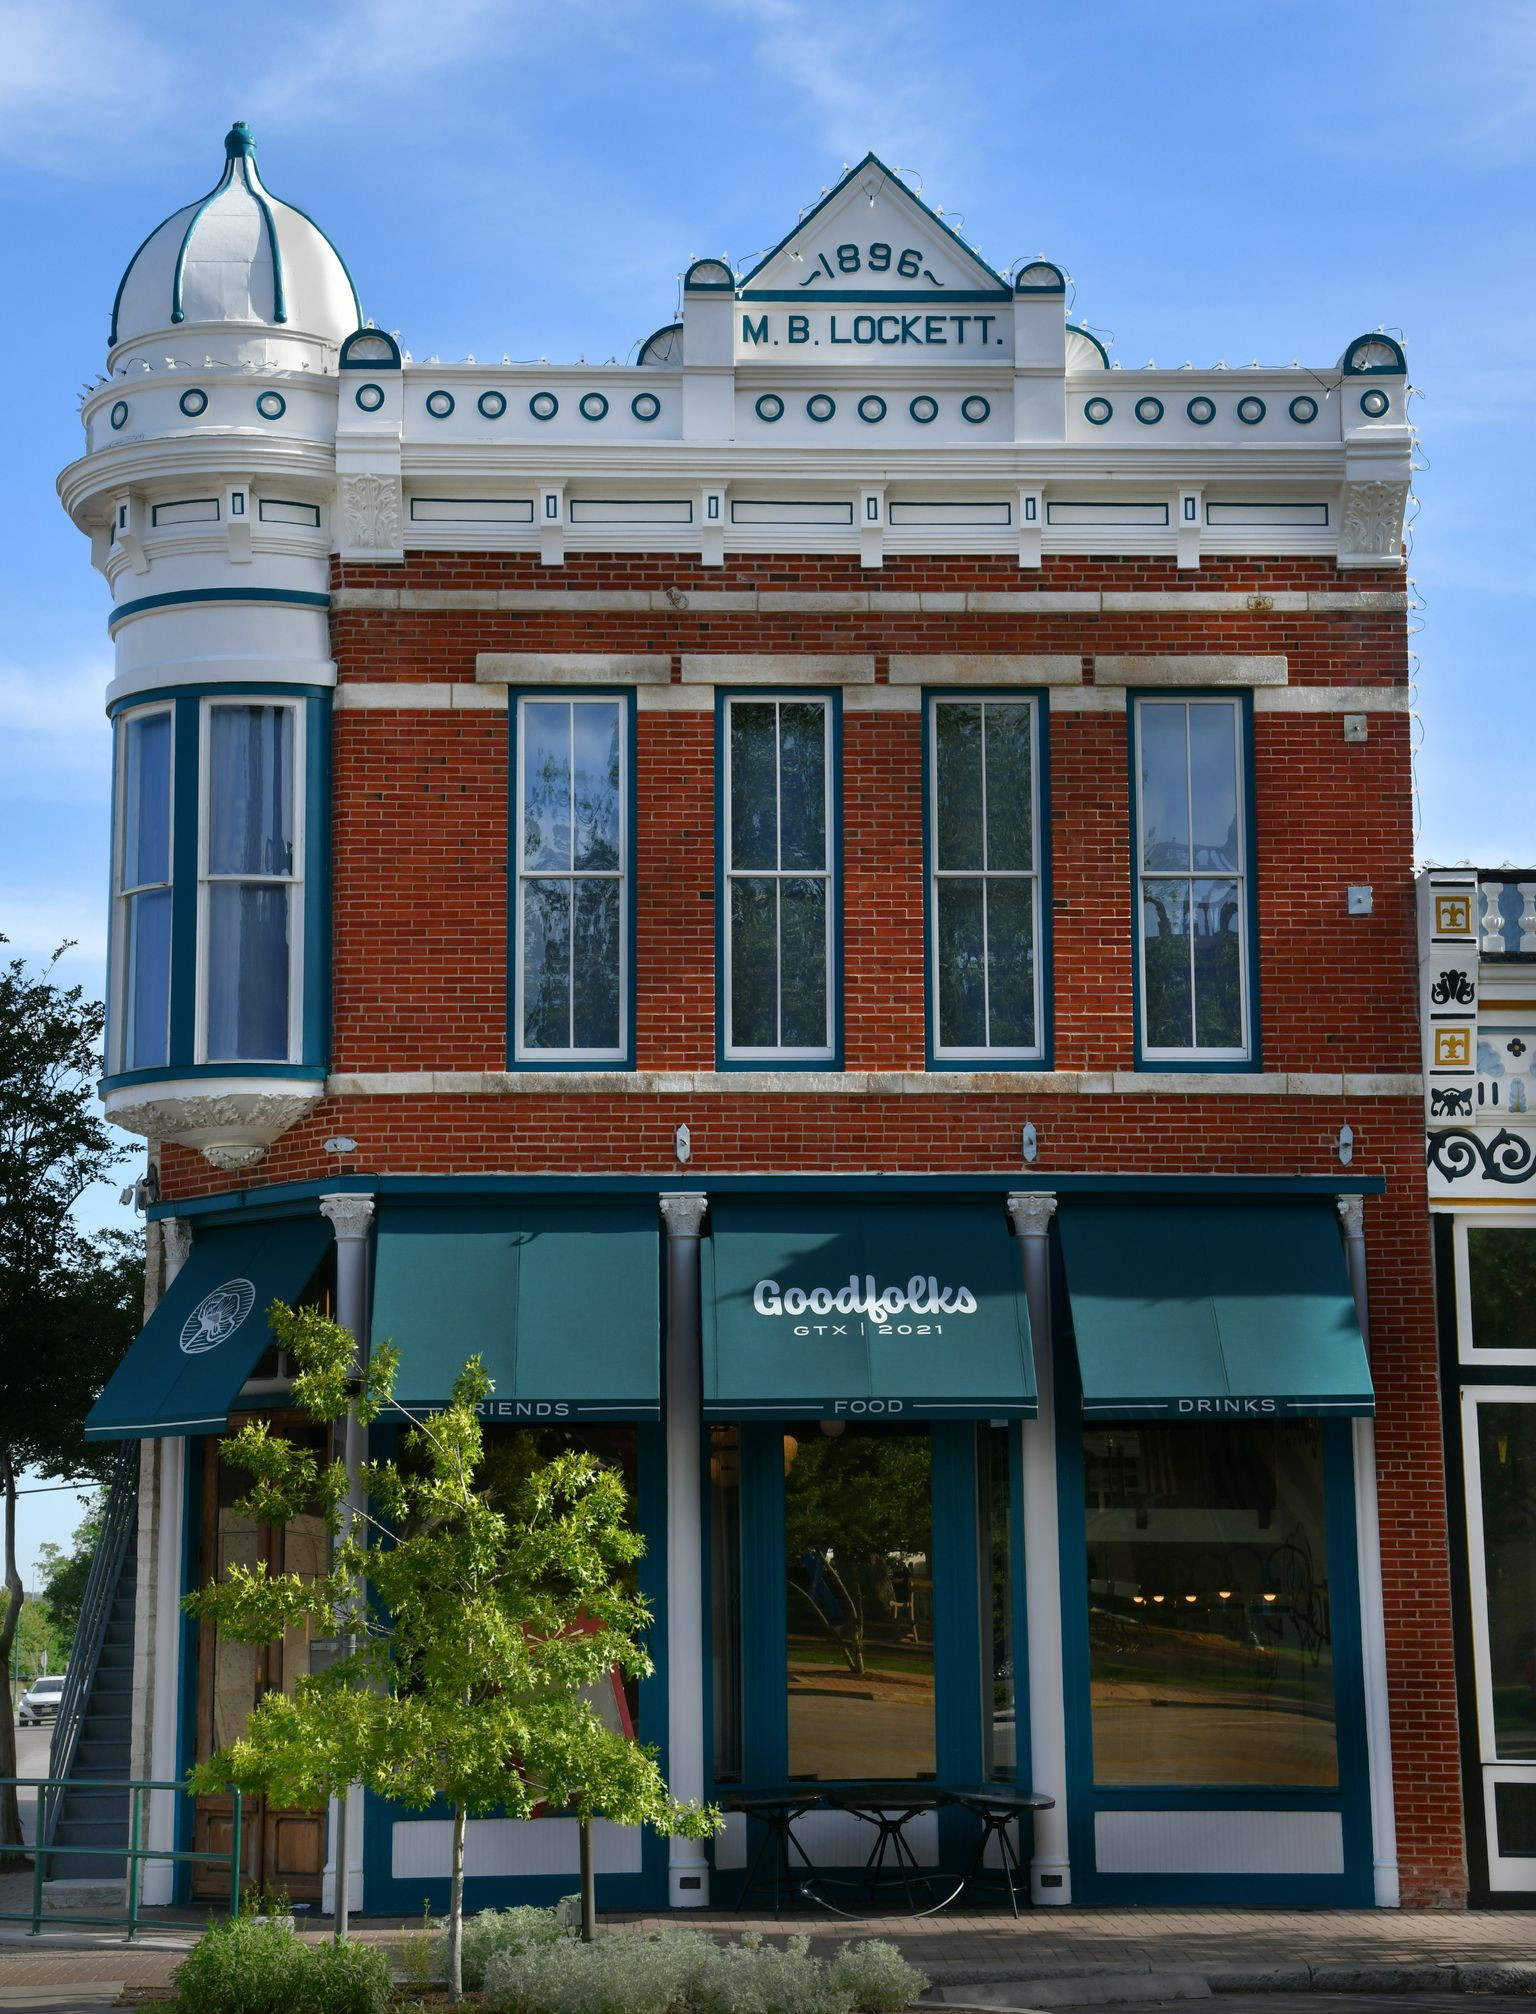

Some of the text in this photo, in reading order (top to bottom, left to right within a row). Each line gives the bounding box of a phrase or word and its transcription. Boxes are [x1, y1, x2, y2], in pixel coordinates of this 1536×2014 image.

[818, 242, 925, 280] 1896
[742, 314, 1004, 346] M. B. LOCKETT.
[753, 1274, 978, 1324] Goodfolks
[793, 1324, 943, 1336] GTX 2021
[454, 1402, 570, 1416] RIENDS
[834, 1400, 904, 1414] FOOD
[1178, 1399, 1276, 1412] DRINKS
